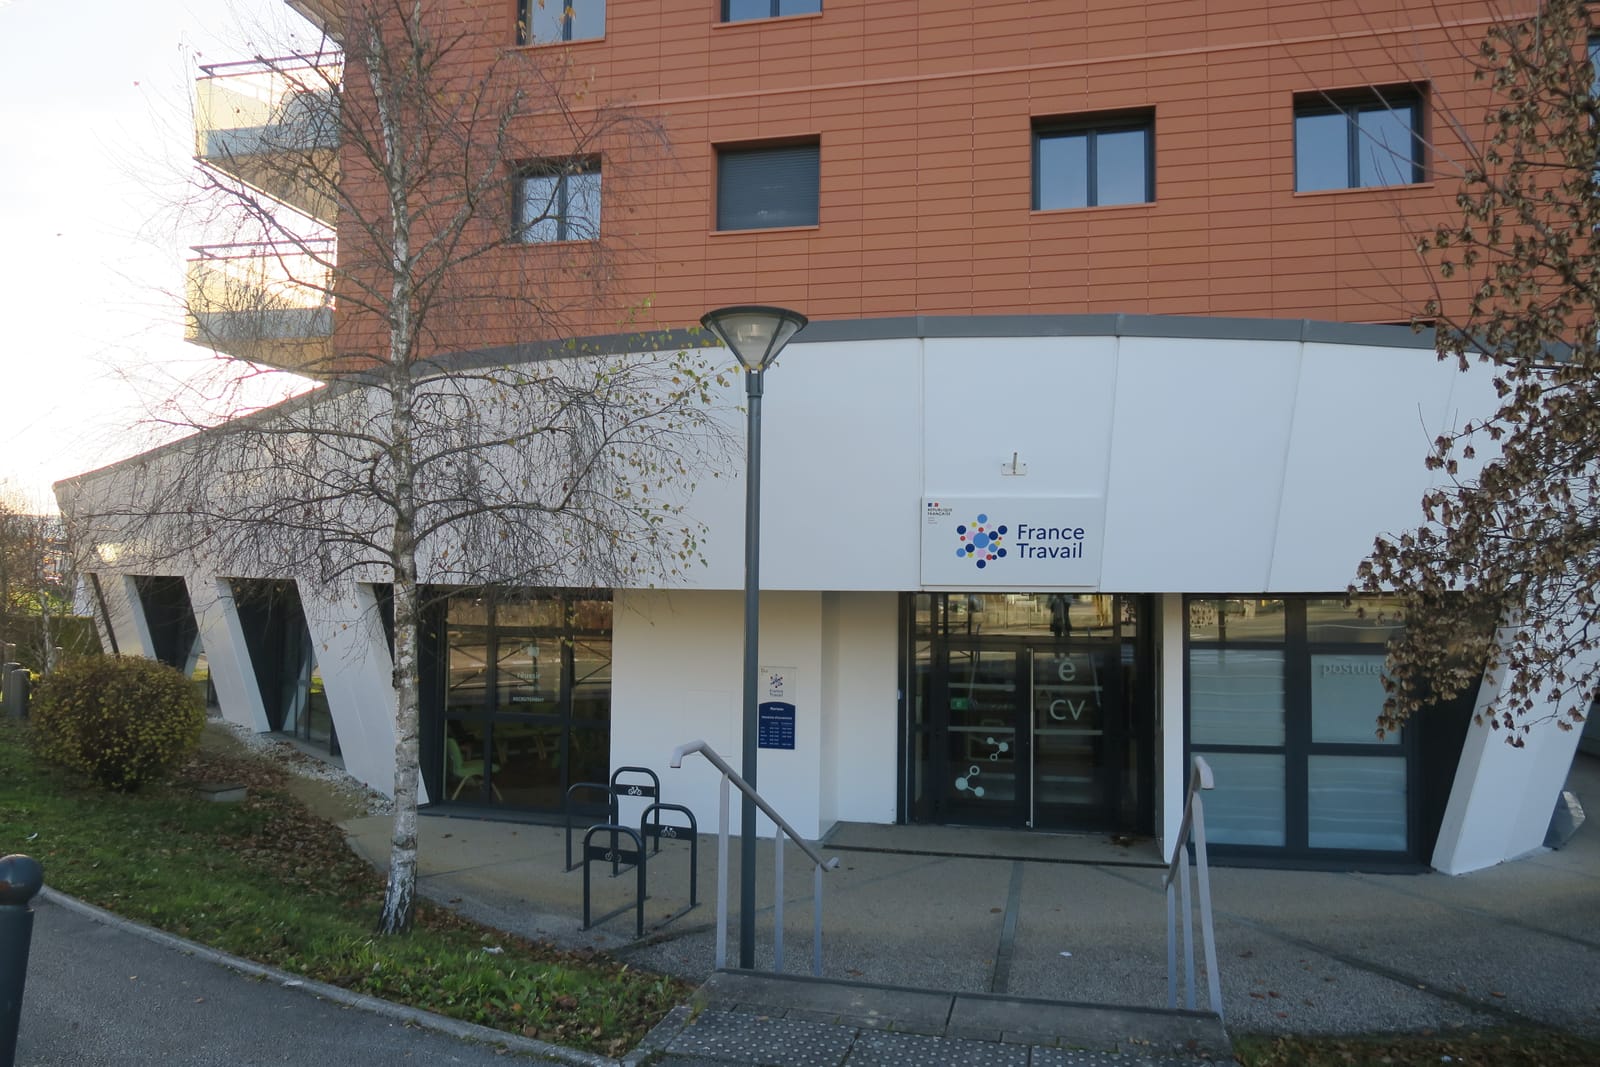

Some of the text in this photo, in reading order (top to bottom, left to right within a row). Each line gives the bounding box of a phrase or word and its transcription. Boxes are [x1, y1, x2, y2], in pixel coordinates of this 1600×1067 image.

[1018, 524, 1085, 540] France
[1016, 542, 1082, 558] Travail
[1050, 699, 1086, 720] CV
